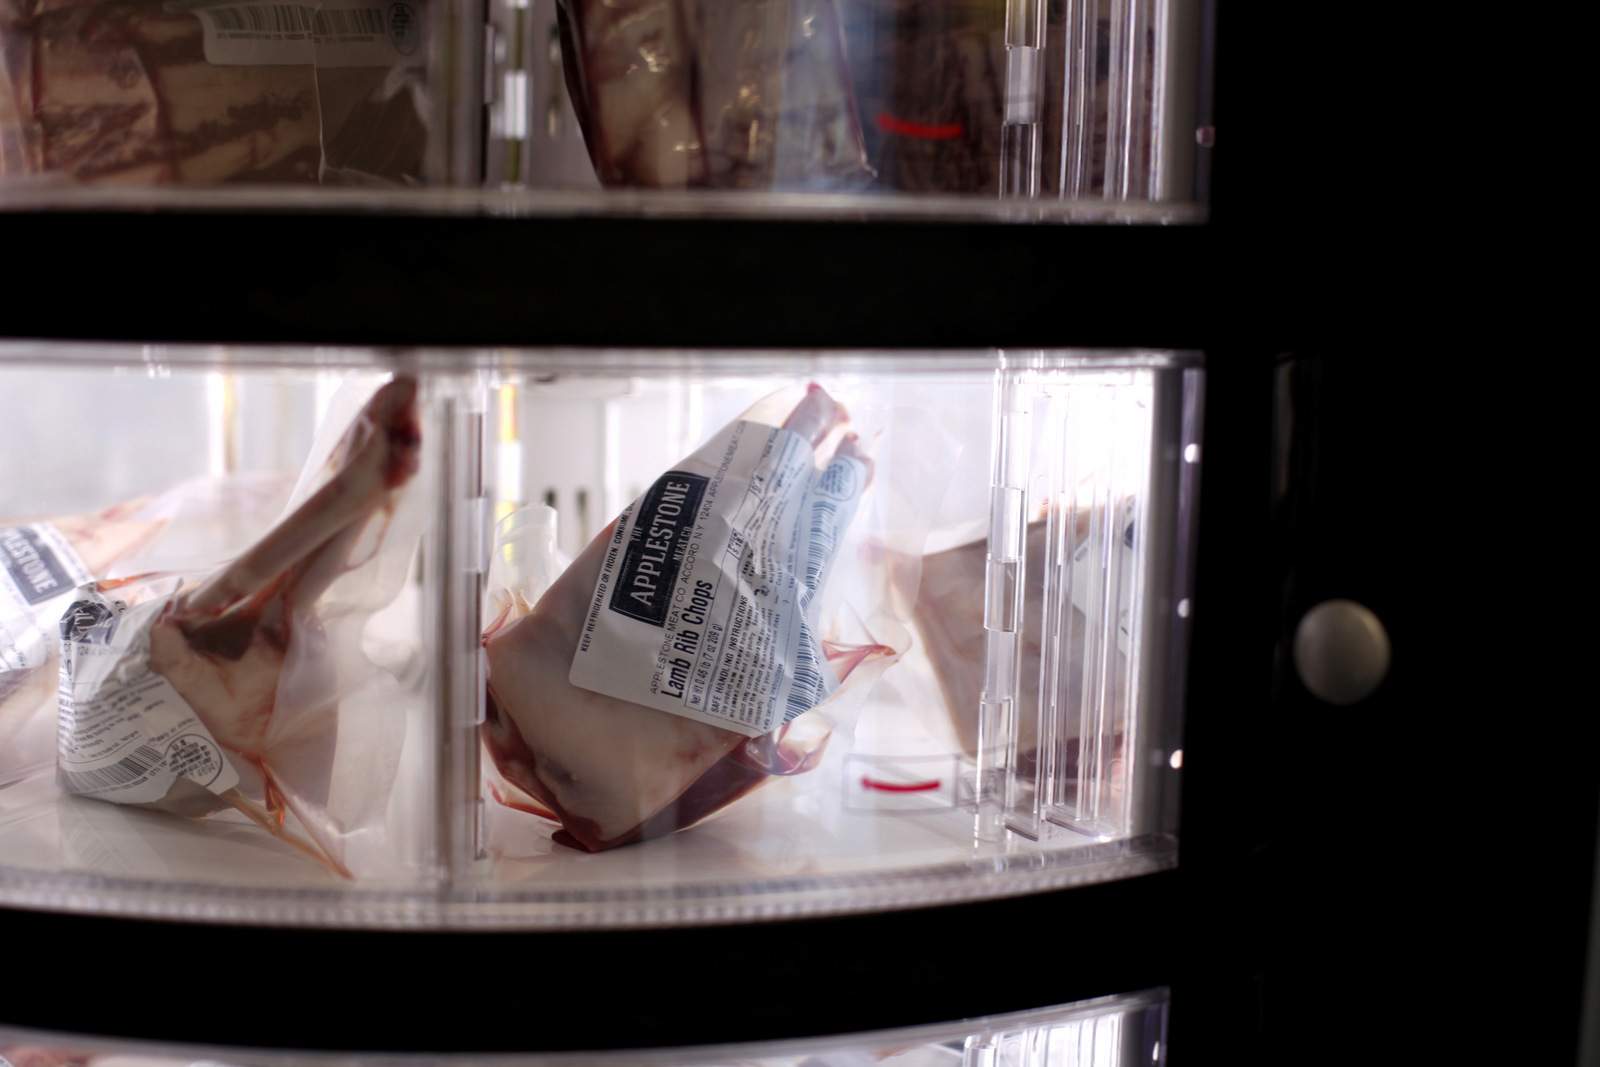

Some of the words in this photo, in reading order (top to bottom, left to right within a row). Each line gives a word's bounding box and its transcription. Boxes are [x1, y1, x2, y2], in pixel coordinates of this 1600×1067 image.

[3, 531, 58, 594] LESTONE
[631, 482, 689, 605] APPLESTONE
[580, 633, 592, 652] KEEP
[586, 583, 607, 632] REFRIGERATED
[600, 572, 610, 583] OR
[650, 633, 674, 694] APPLESTONE
[666, 604, 681, 632] MEAT
[680, 542, 699, 584] ACCORD
[681, 580, 714, 625] Chops
[728, 595, 748, 651] INSTRUCTIONS
[673, 630, 700, 654] Rib
[661, 658, 691, 699] Lamb
[715, 652, 734, 694] HANDLING
[710, 695, 721, 713] SAFE
